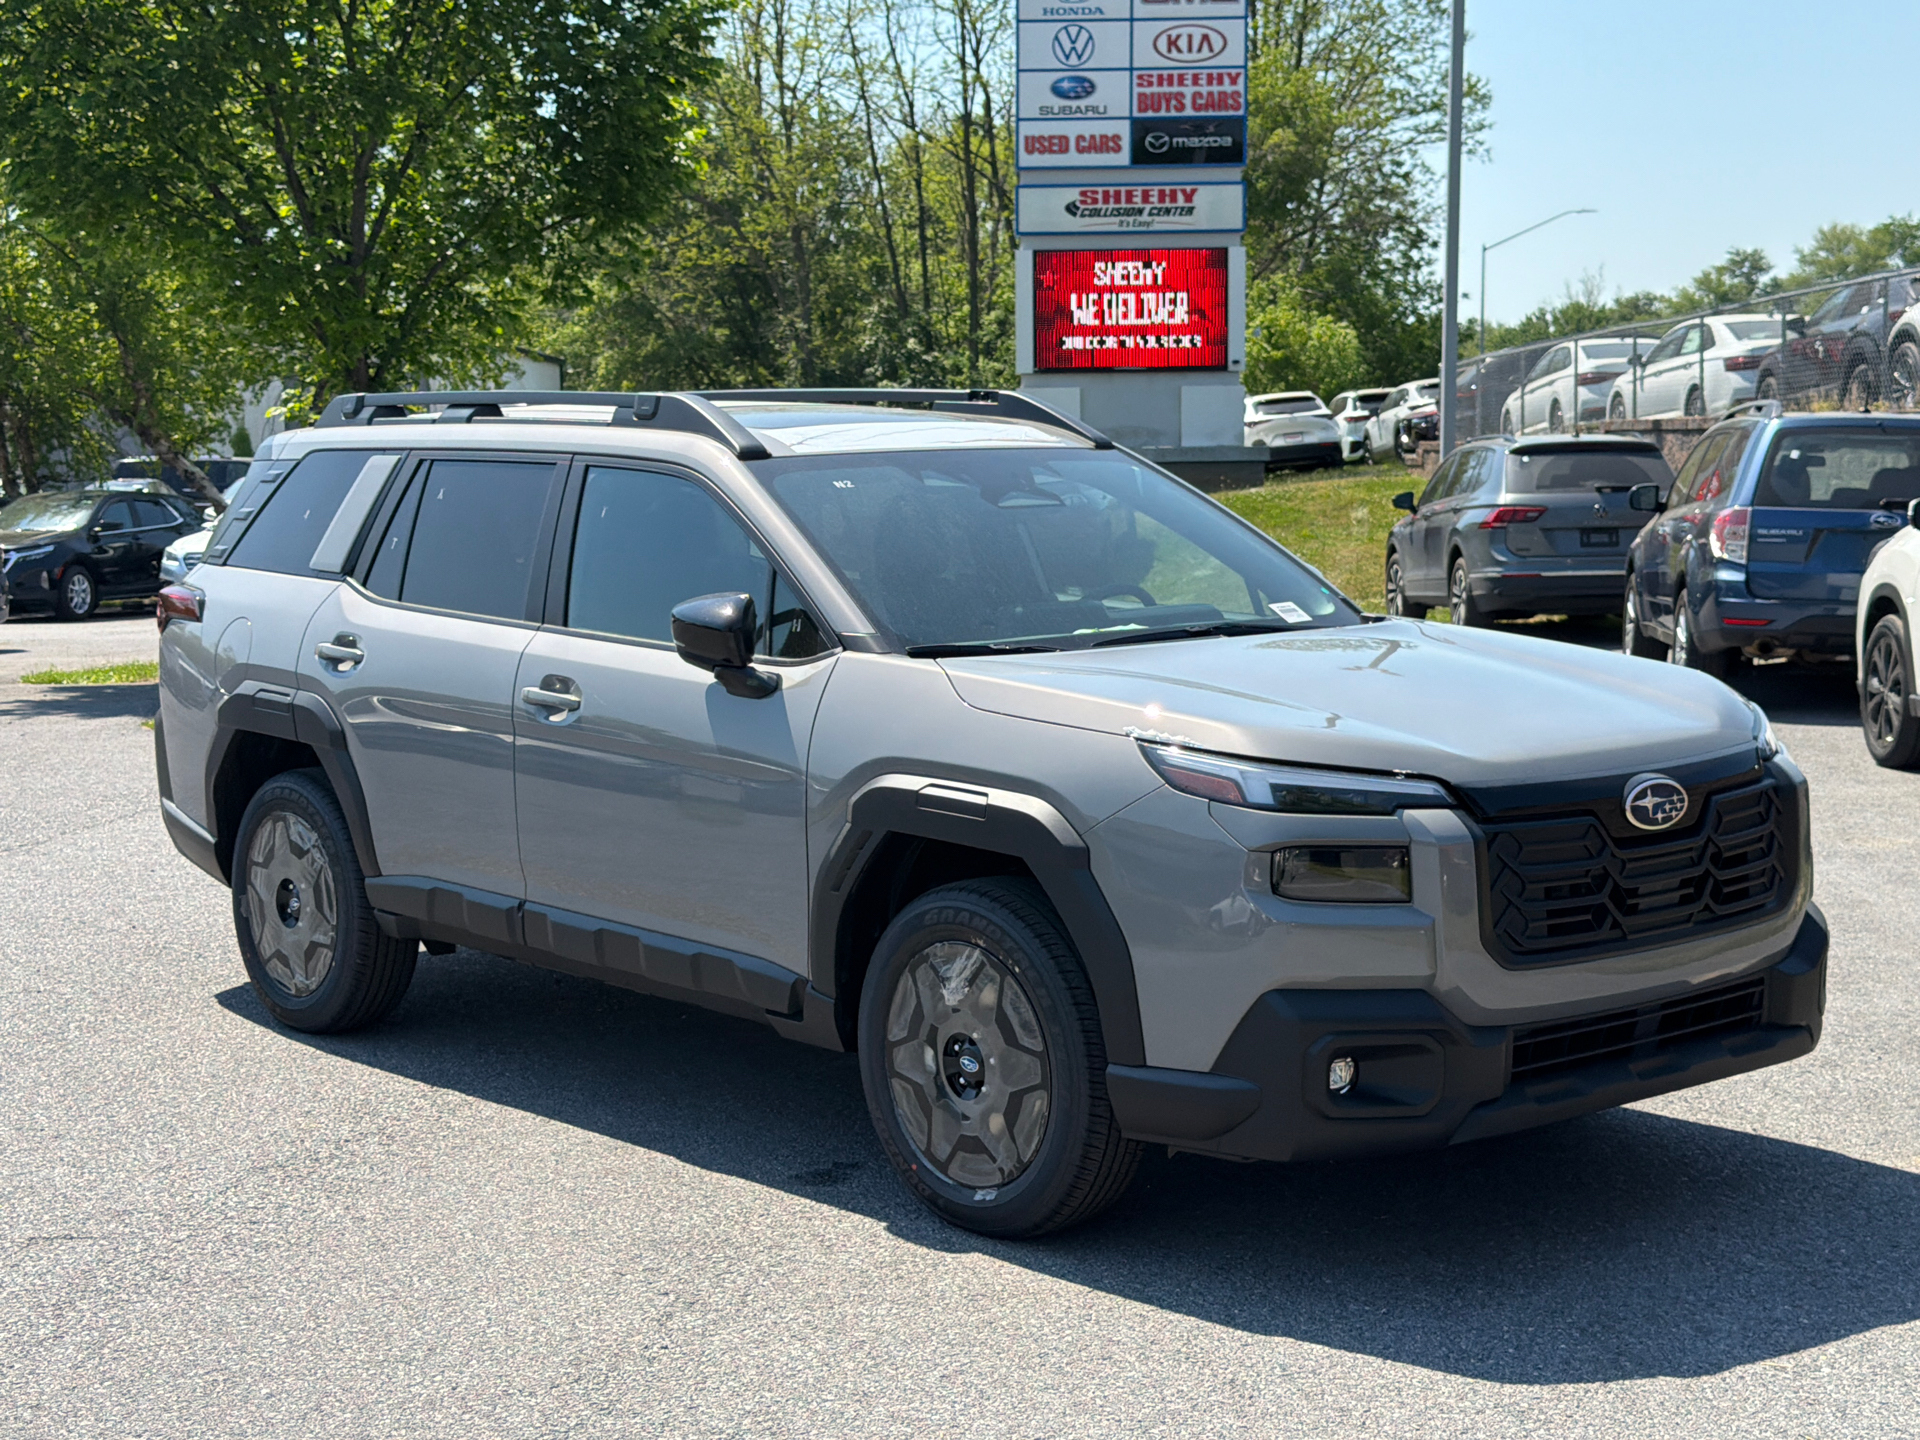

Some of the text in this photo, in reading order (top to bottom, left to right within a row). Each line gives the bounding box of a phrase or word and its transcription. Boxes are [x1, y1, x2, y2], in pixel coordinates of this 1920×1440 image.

[1042, 7, 1105, 16] HONDA
[1166, 33, 1215, 54] KIA
[1136, 72, 1242, 88] SHEEHY
[1038, 105, 1107, 116] SUBARU
[1137, 91, 1242, 114] BUYS CARS
[1024, 134, 1122, 155] USED CARS
[1172, 135, 1233, 148] mazda
[1079, 188, 1198, 206] SHEEHY
[1079, 206, 1196, 218] COLLISION CENTER
[1118, 219, 1131, 228] It's
[1093, 261, 1166, 286] SHEEHY
[1070, 293, 1099, 326] WE
